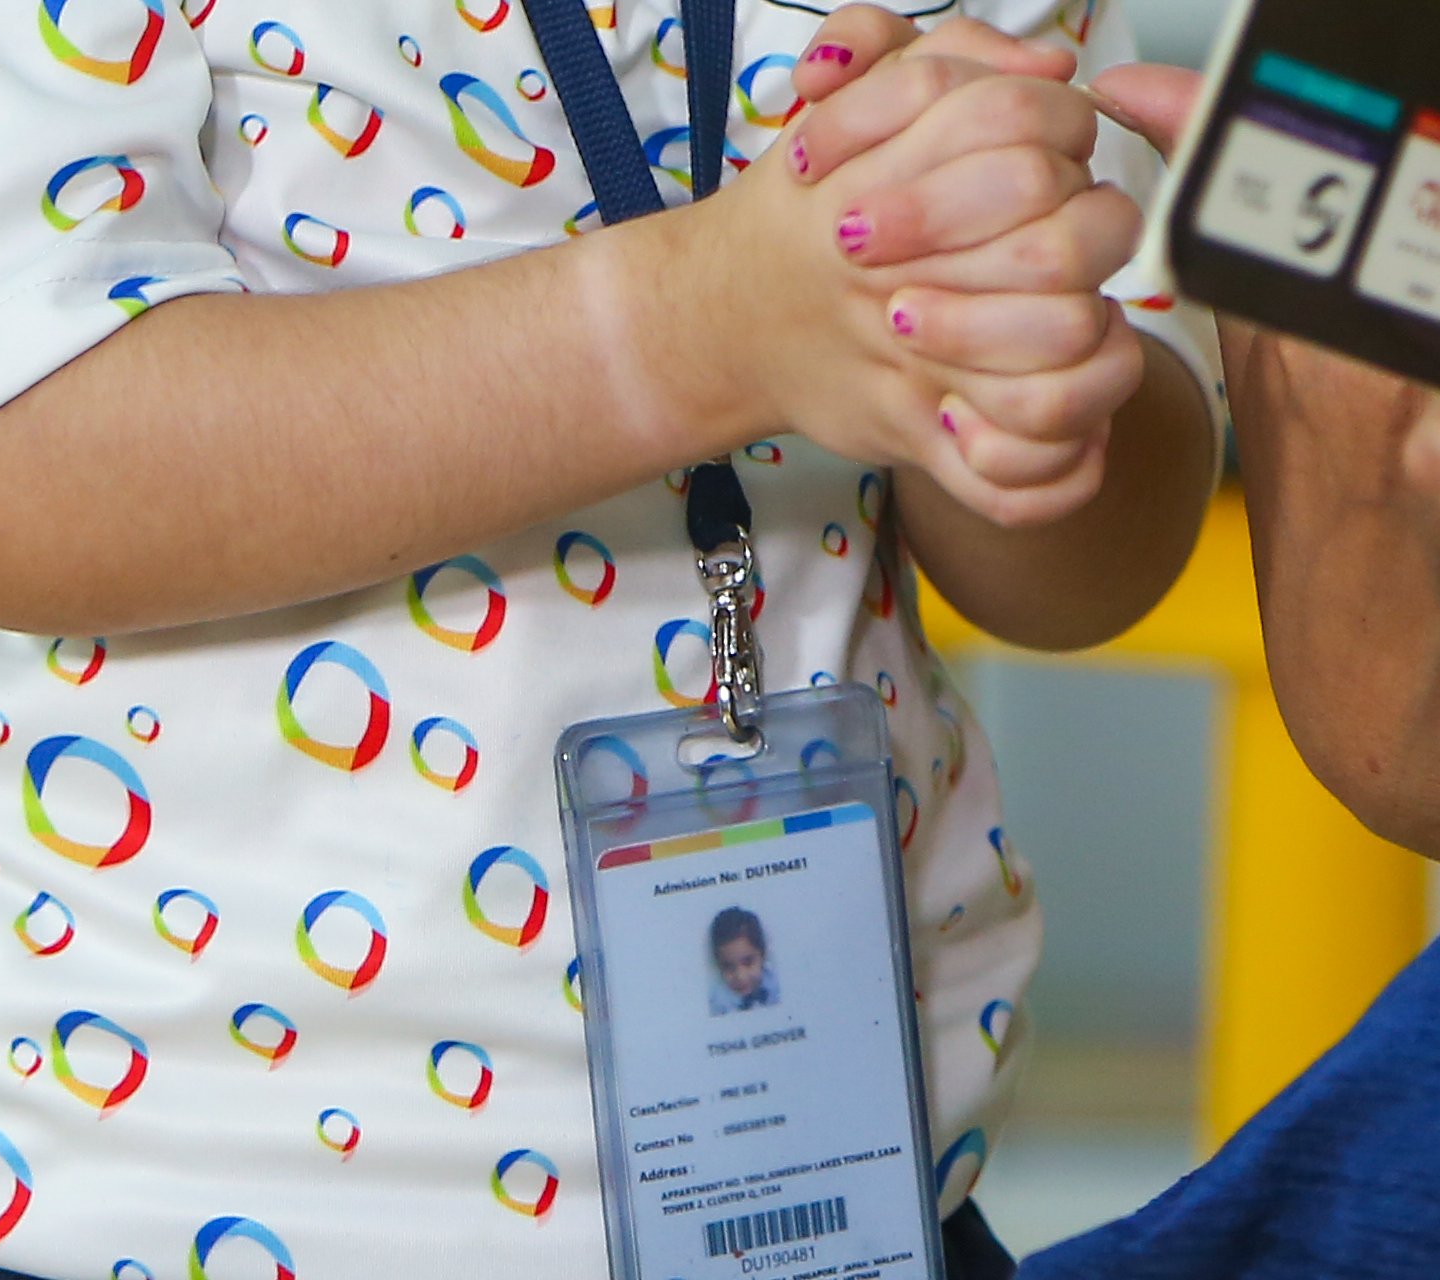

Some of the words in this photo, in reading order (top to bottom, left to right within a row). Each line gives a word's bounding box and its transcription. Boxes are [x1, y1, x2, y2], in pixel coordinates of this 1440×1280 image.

[654, 875, 717, 896] Admission
[630, 1097, 700, 1118] Class/Section
[634, 1137, 675, 1154] Contact
[677, 1133, 694, 1145] No
[639, 1165, 688, 1183] Address
[662, 1199, 696, 1216] TOWER
[707, 1192, 747, 1208] CLUSTER
[741, 1246, 816, 1273] DU190481
